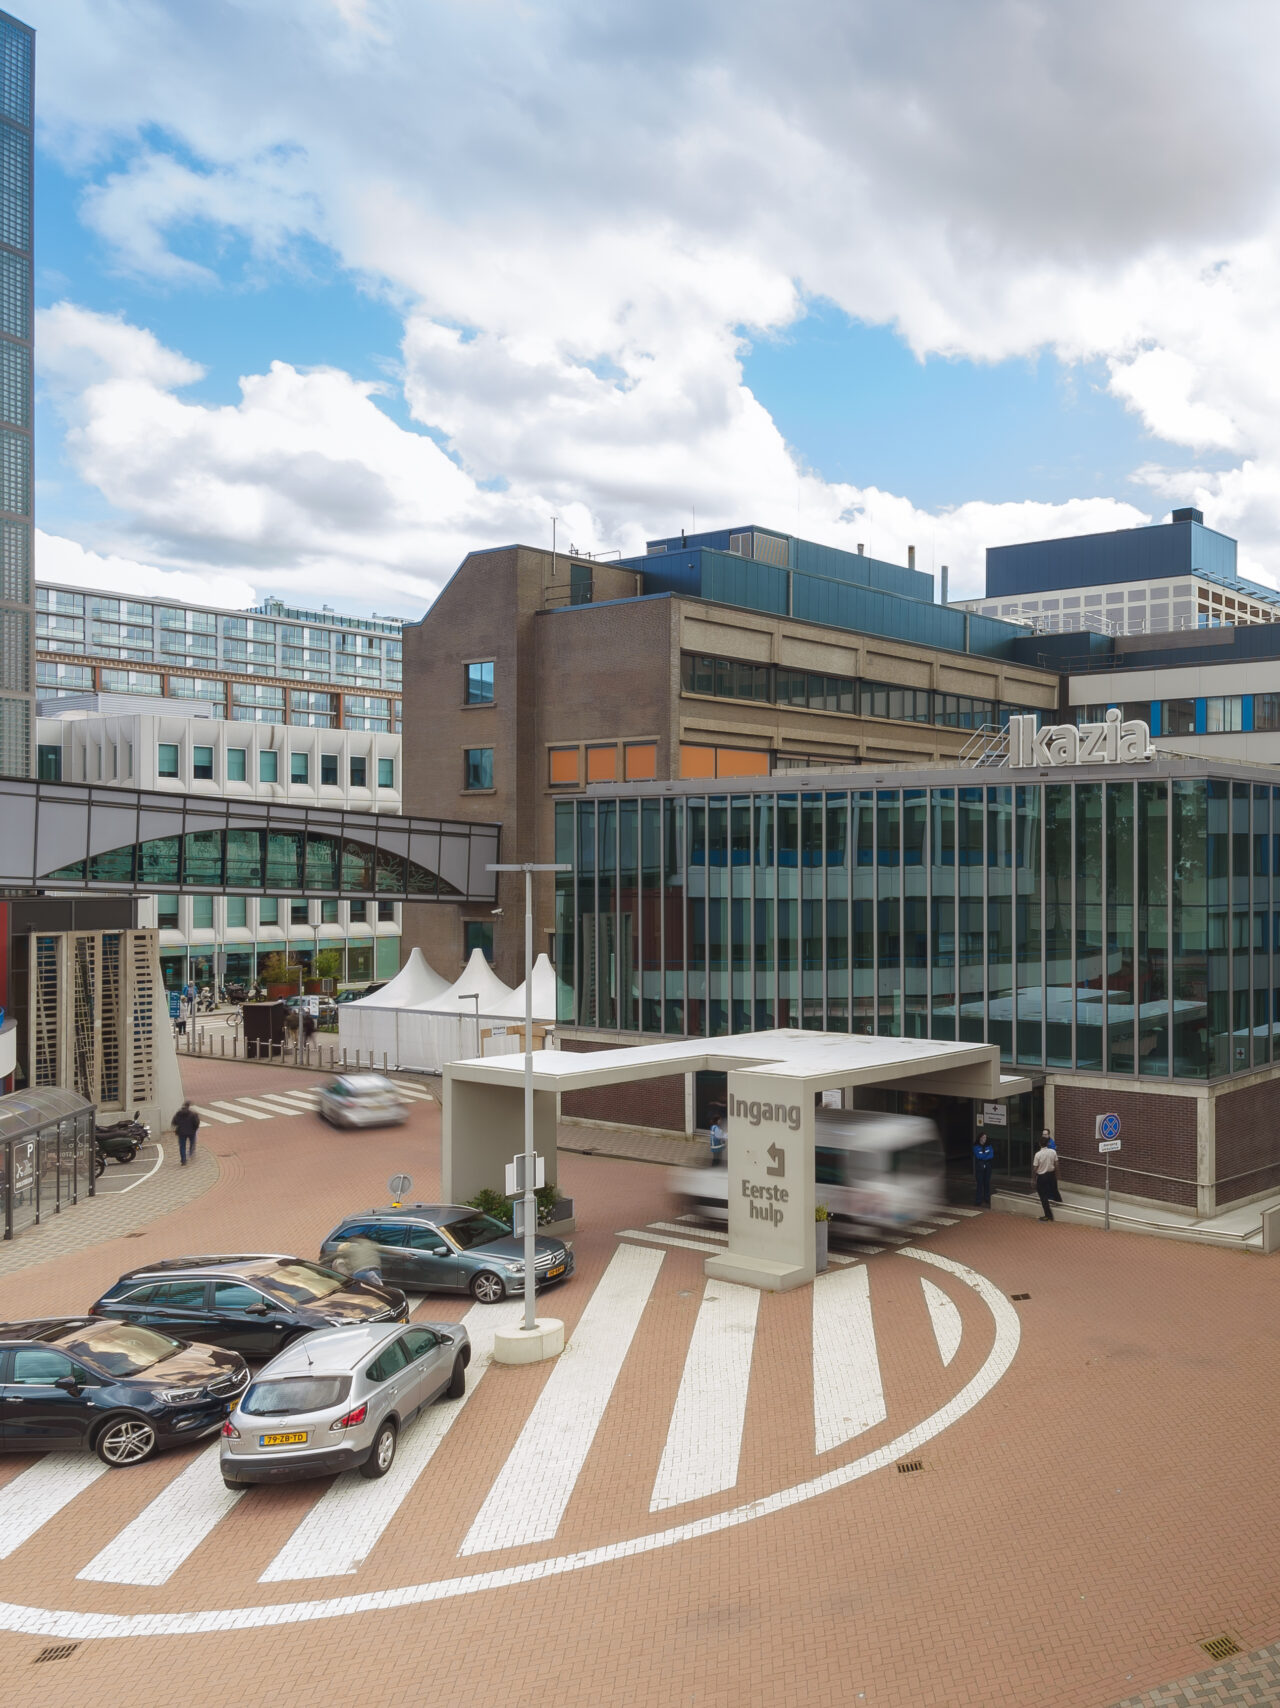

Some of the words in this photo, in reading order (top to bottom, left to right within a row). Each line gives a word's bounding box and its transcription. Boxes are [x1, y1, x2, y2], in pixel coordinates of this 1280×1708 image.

[1009, 708, 1150, 768] Ikazia
[729, 1093, 801, 1131] Ingang
[27, 1144, 33, 1158] P
[741, 1179, 789, 1203] Eerste
[749, 1200, 784, 1228] hulp
[267, 1434, 304, 1443] 79-ZB-TD
